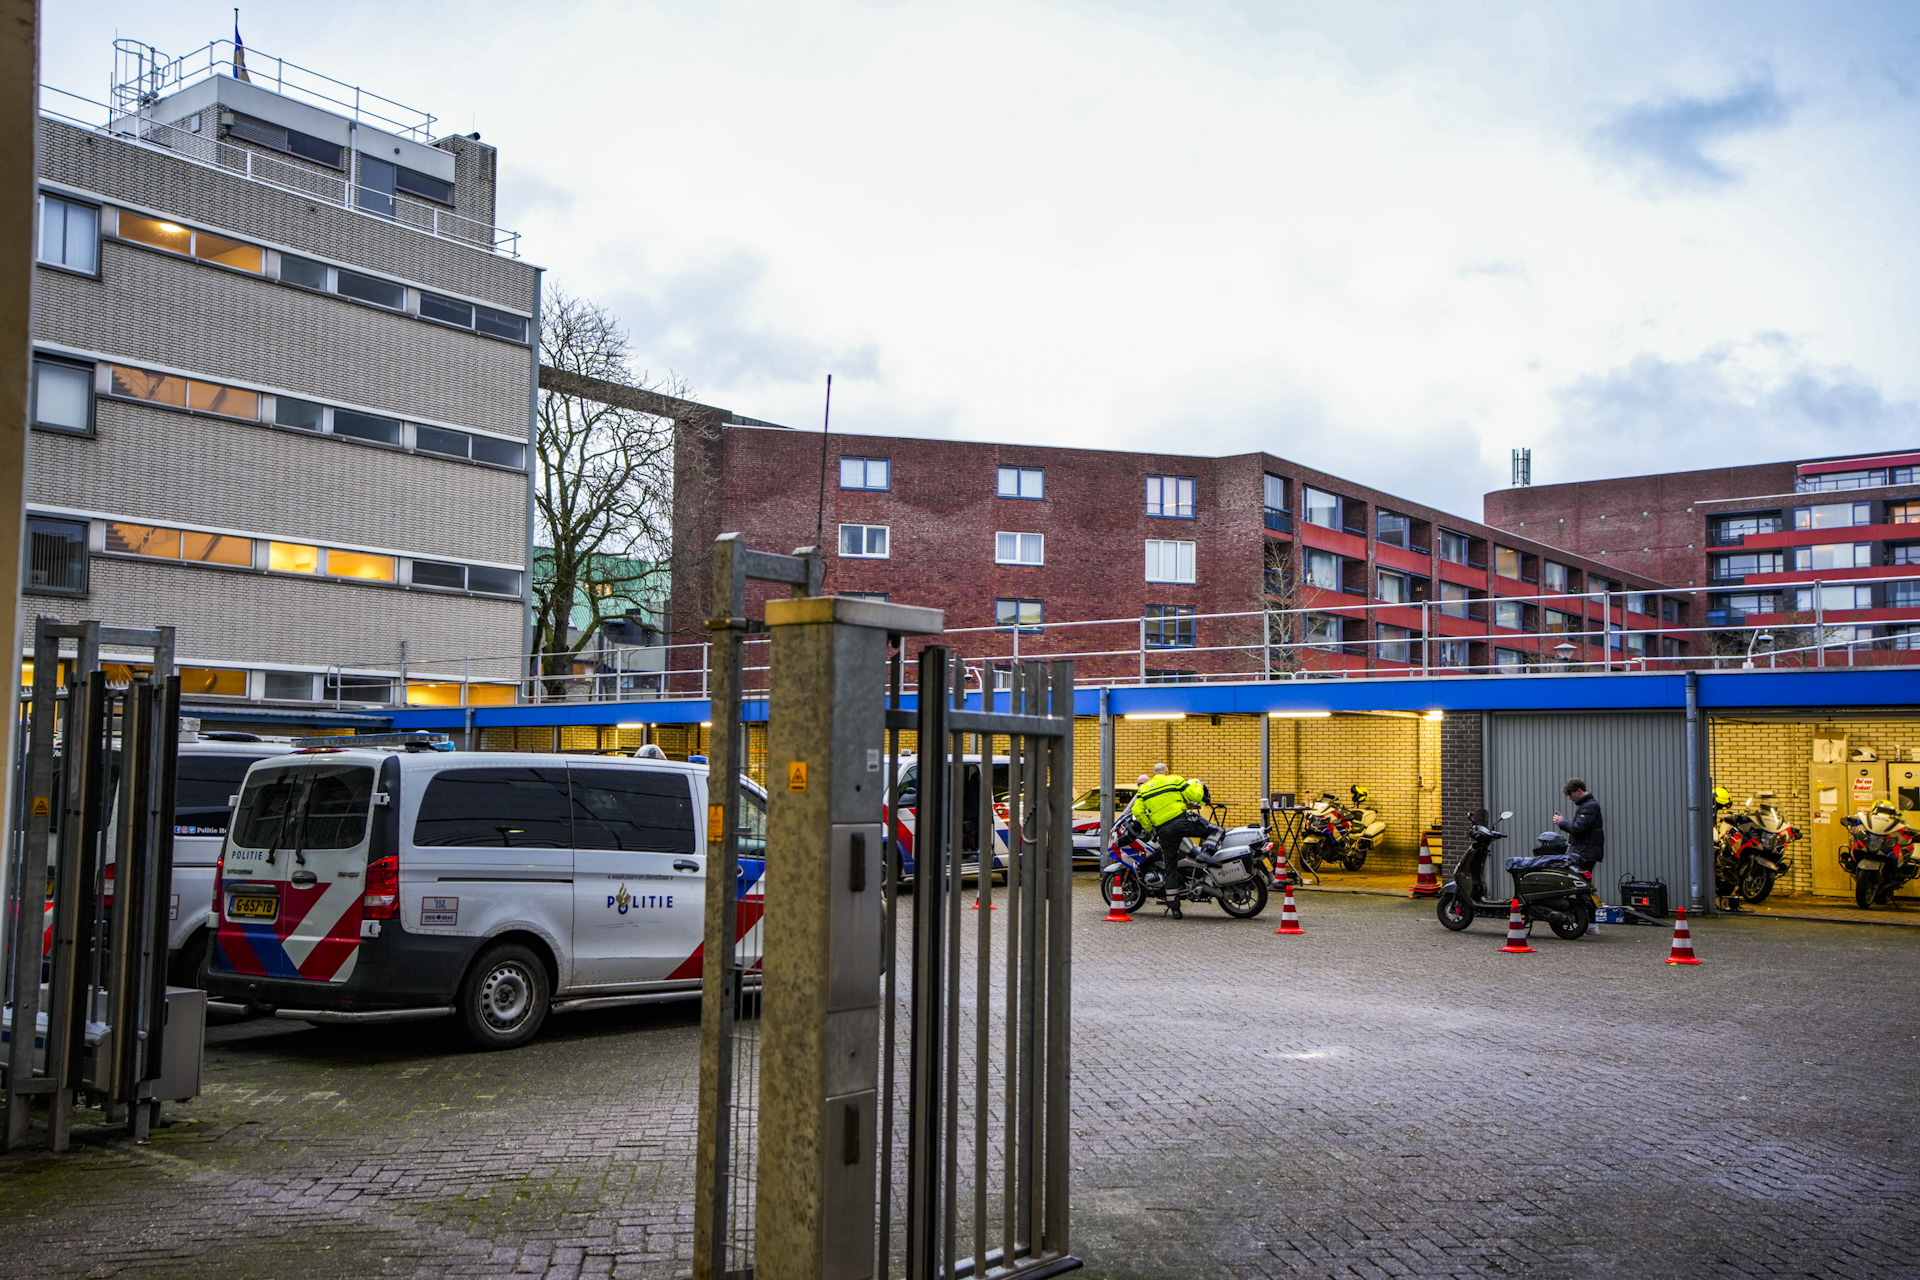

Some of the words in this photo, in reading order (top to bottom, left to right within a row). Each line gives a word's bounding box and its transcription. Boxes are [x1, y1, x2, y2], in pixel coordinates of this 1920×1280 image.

[231, 851, 263, 860] POLITIE
[236, 899, 273, 913] G-657-TB
[607, 896, 673, 914] POLITIE
